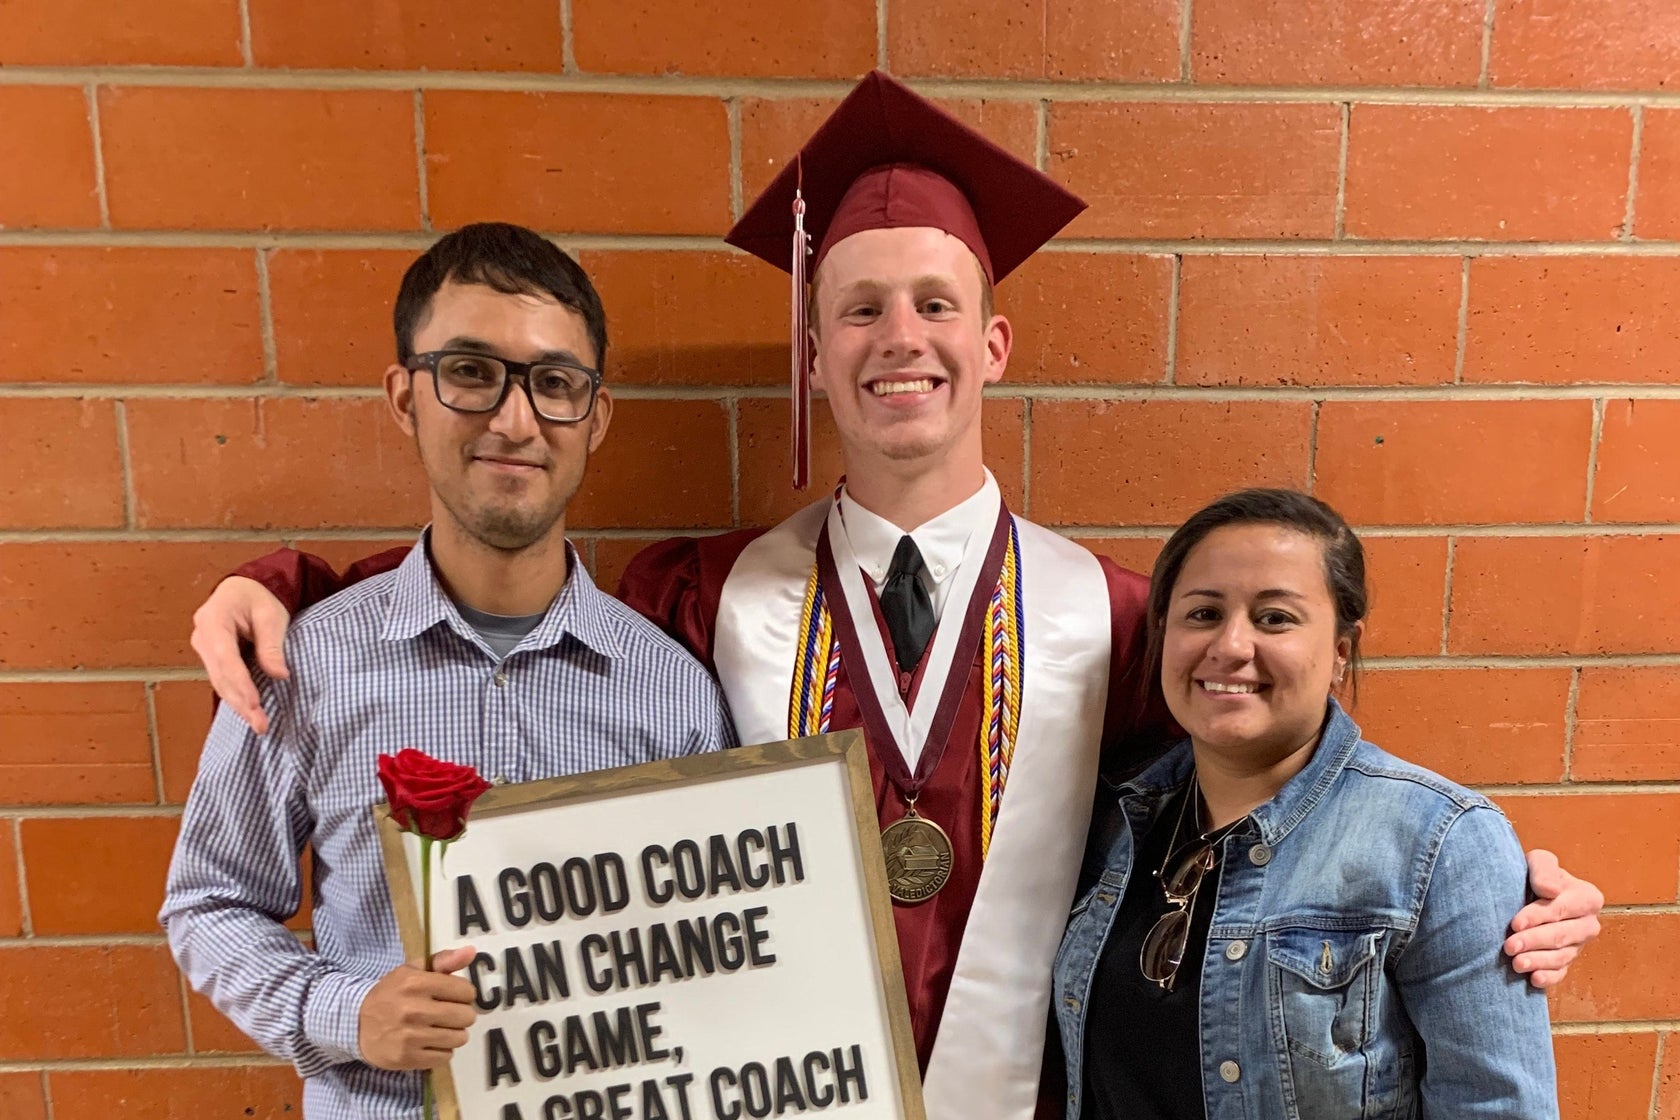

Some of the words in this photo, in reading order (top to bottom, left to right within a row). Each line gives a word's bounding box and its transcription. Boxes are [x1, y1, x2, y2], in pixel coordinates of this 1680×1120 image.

[457, 874, 491, 936] A
[498, 852, 630, 928] GOOD
[641, 822, 805, 905] COACH
[892, 852, 950, 898] VALEDICTORIAN
[468, 940, 570, 1011] CAN
[580, 906, 777, 993] CHANGE
[486, 1027, 521, 1087] A
[527, 1001, 683, 1079] GAME,
